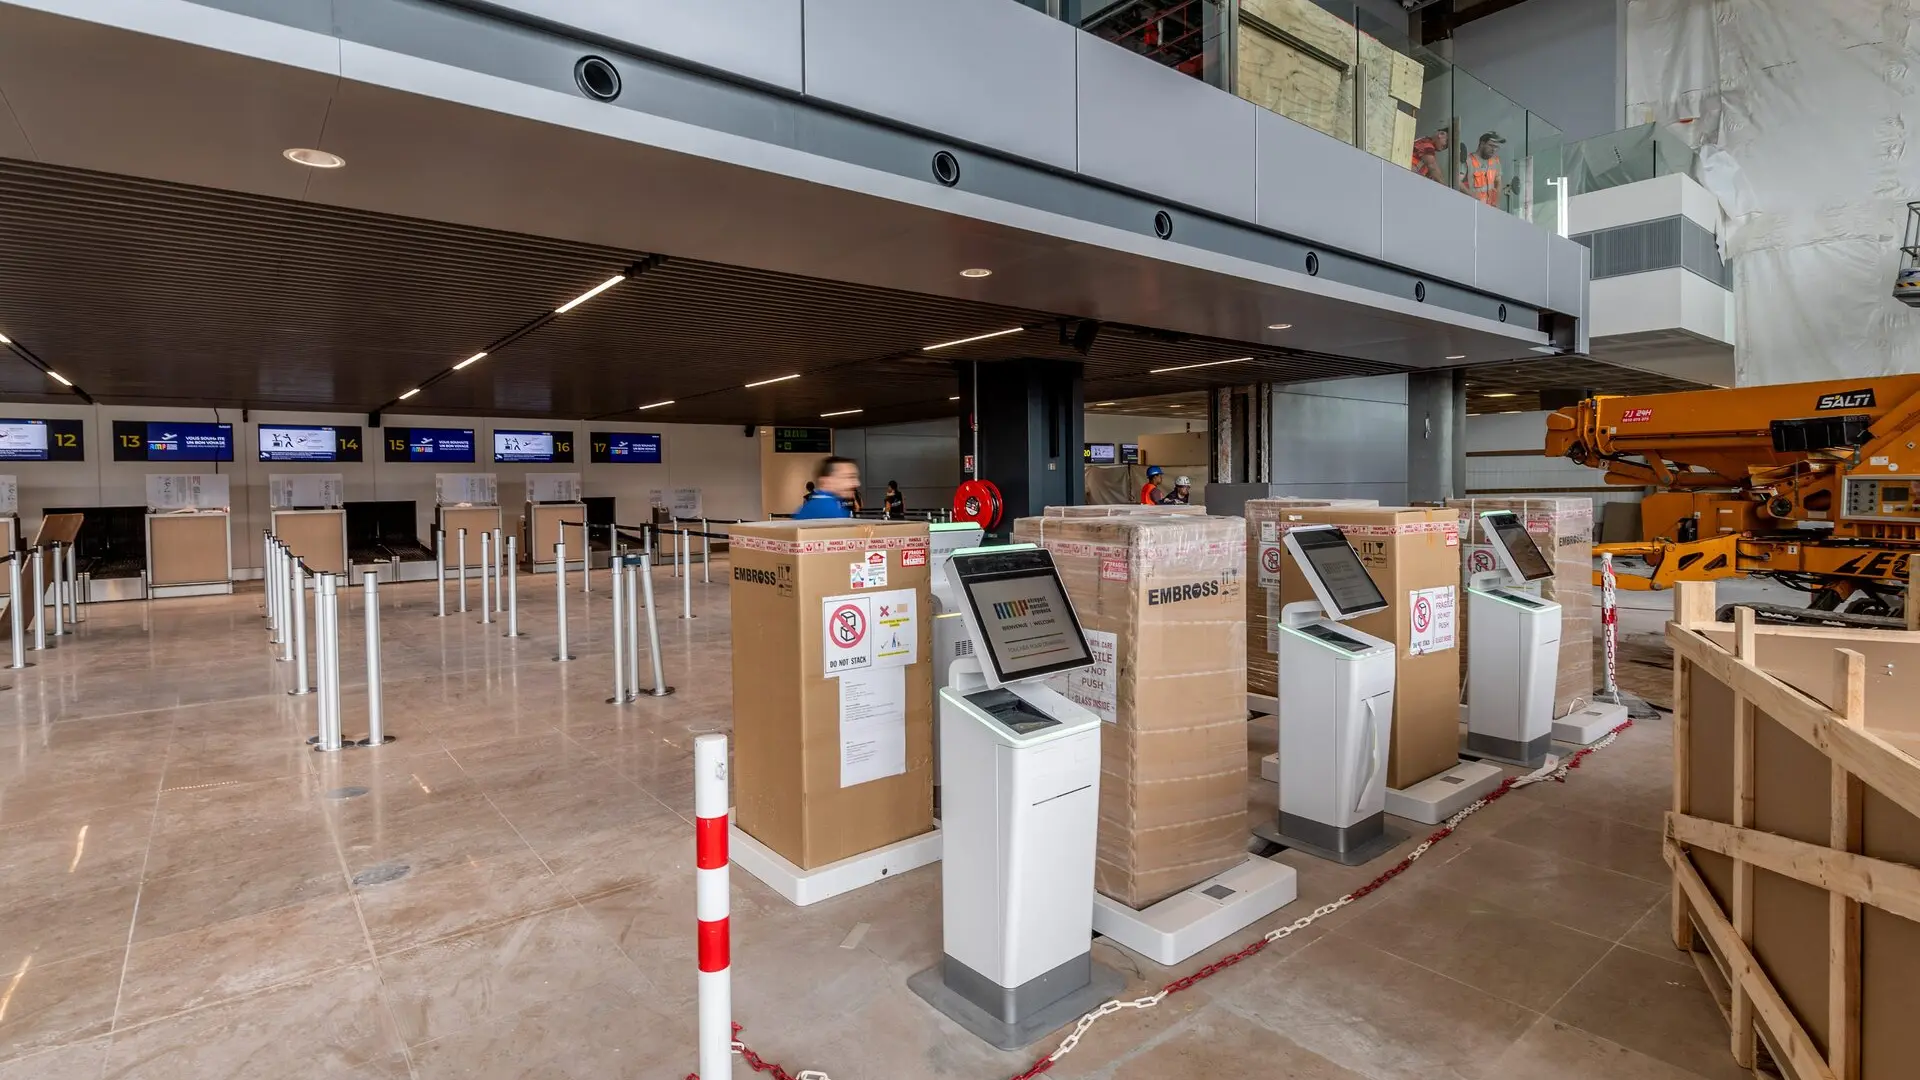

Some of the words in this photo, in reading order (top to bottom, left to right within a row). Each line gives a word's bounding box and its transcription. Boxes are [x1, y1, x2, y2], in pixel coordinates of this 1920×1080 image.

[54, 433, 77, 447] 12
[120, 435, 140, 448] 13
[340, 439, 358, 450] 14
[389, 440, 404, 451] 15
[556, 442, 570, 452] 16
[594, 443, 606, 452] 17
[734, 567, 776, 586] EMBROSS
[1149, 580, 1218, 605] EMBROSS
[851, 656, 866, 664] STACK
[1092, 651, 1112, 664] GILE
[1091, 667, 1107, 676] NOT
[1082, 678, 1104, 690] PUSH
[1075, 694, 1091, 706] GLASS
[1093, 700, 1110, 711] INSIDE
